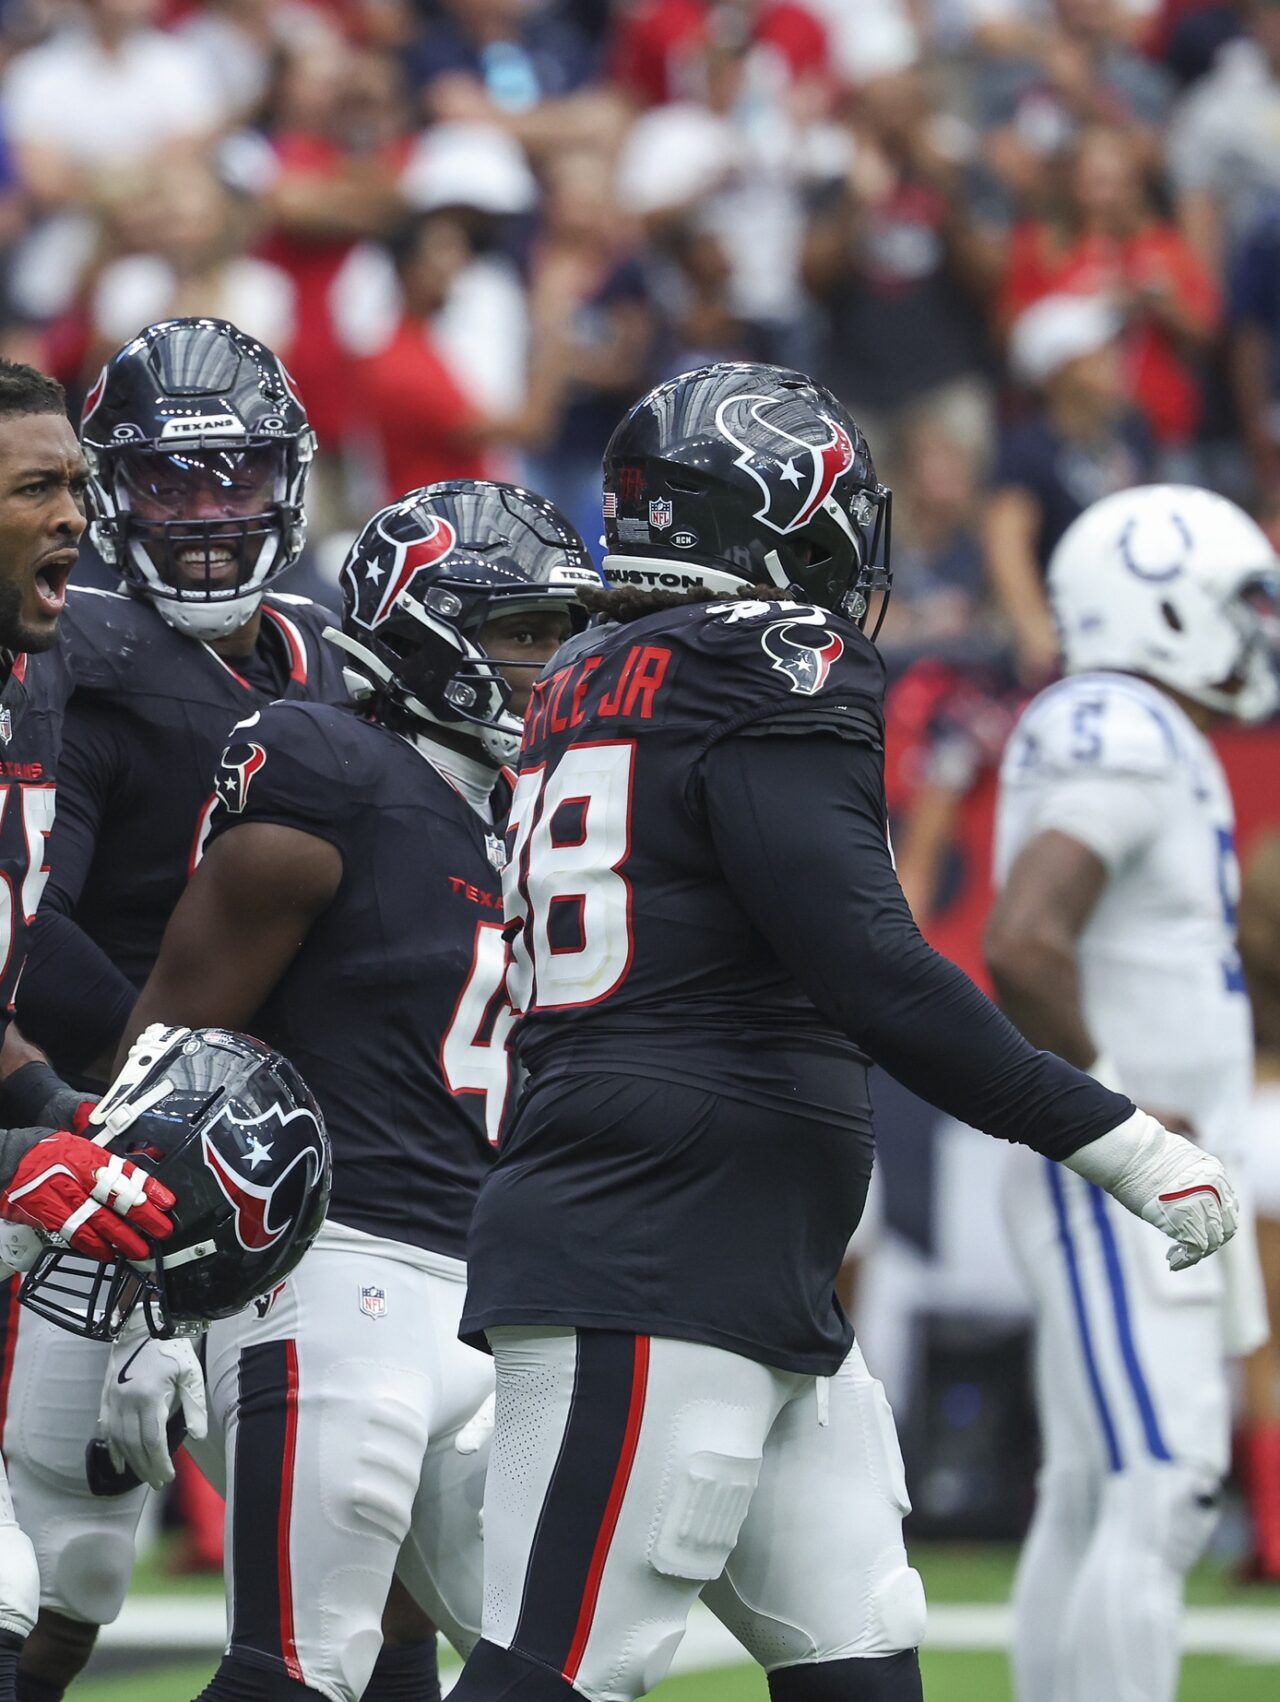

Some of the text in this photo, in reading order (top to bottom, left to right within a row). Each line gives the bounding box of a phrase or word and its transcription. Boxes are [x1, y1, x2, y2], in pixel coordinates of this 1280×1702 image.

[172, 419, 234, 433] TEXANS
[652, 512, 669, 524] NFL
[521, 645, 672, 752] TTLE JR
[1073, 698, 1104, 763] 5
